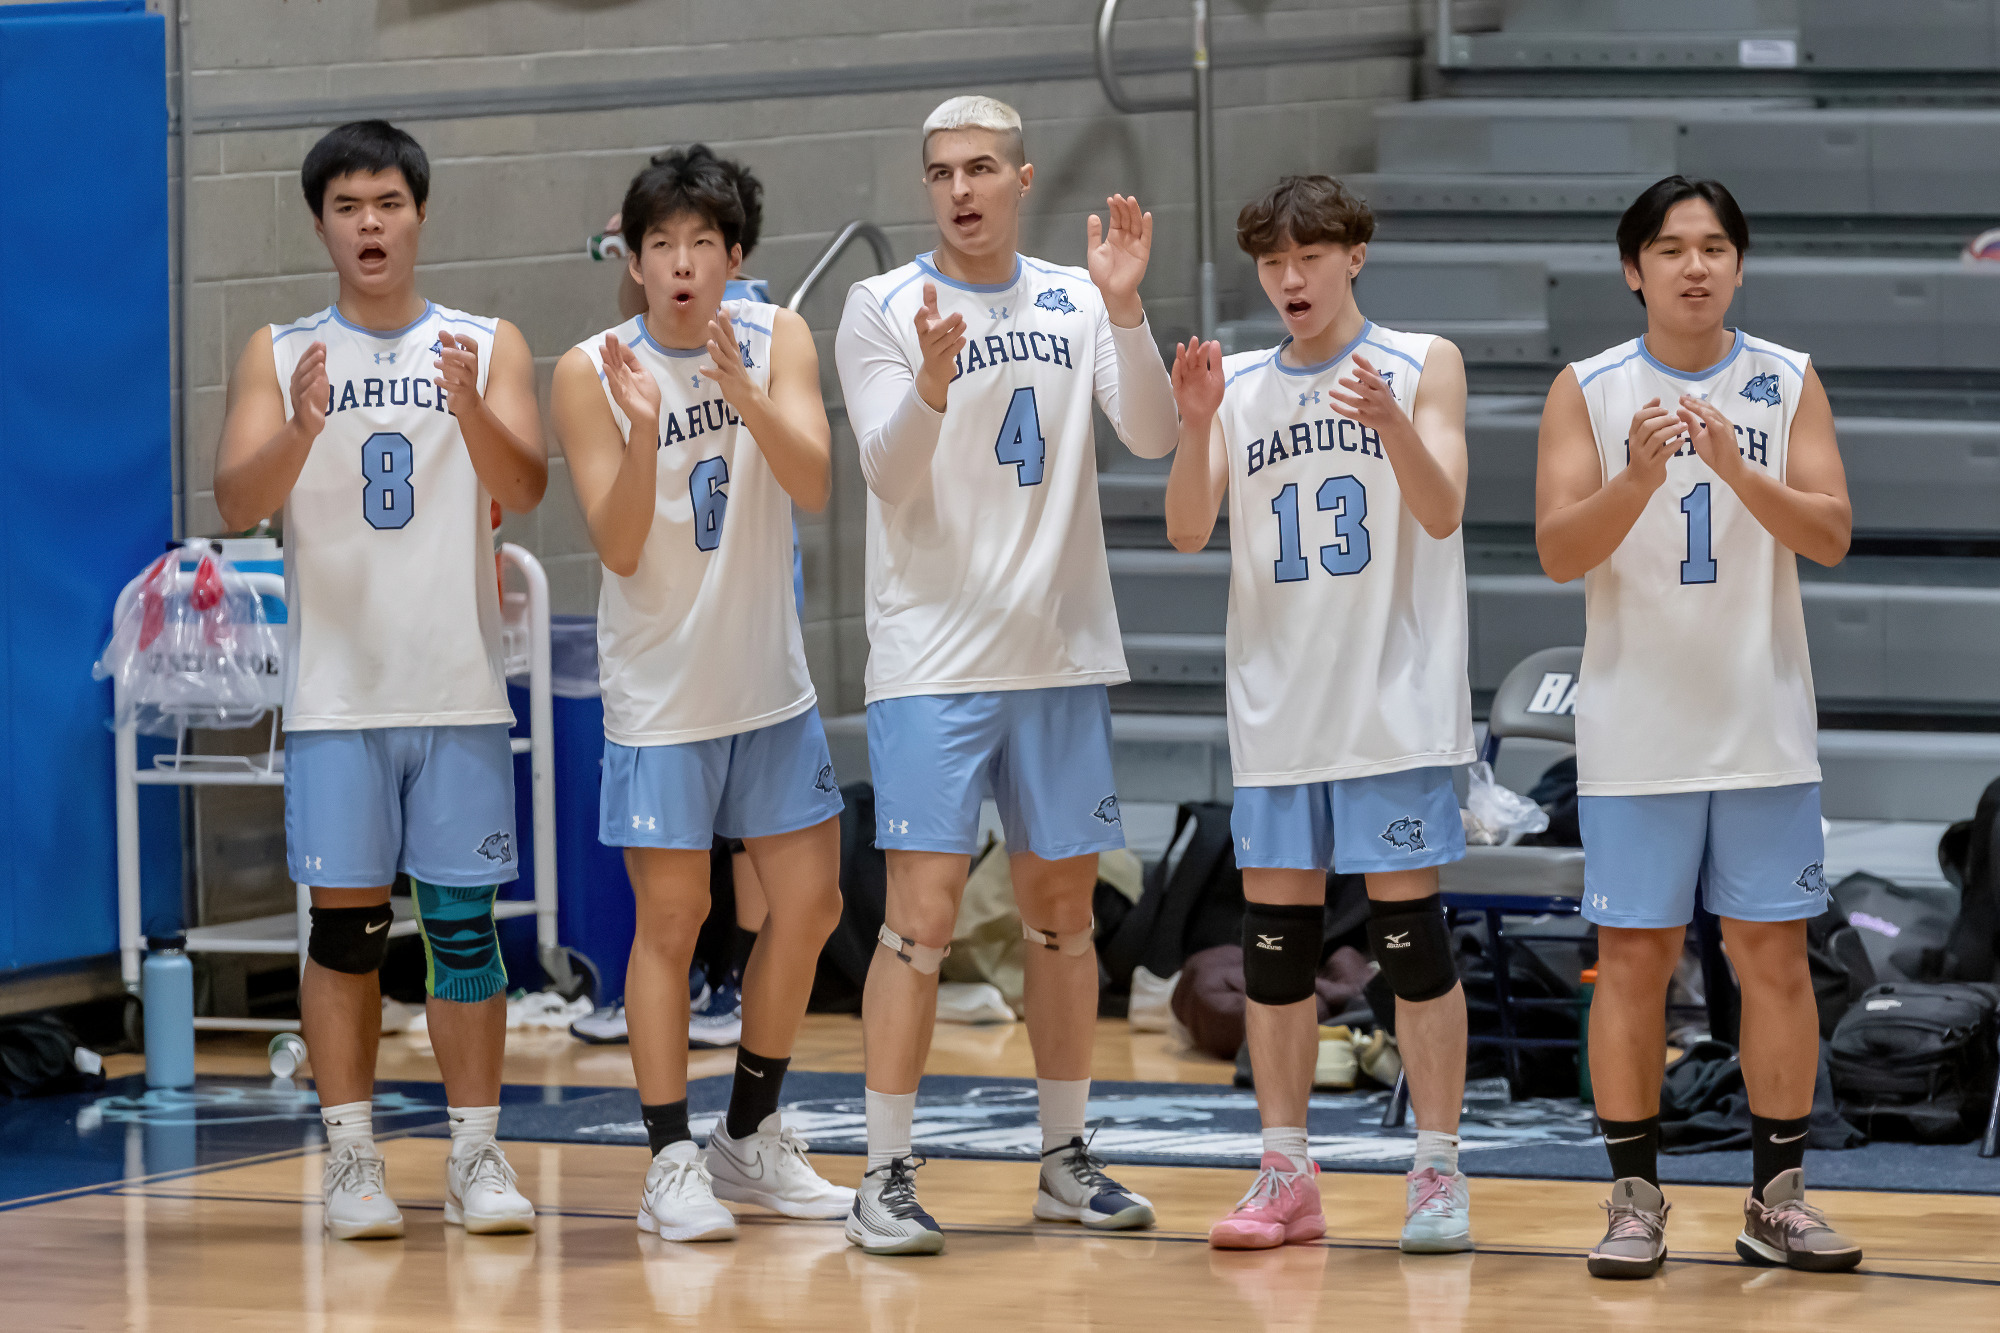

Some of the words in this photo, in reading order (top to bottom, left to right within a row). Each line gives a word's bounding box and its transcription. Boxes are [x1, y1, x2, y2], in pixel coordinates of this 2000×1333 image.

[657, 399, 747, 451] ARUC
[995, 386, 1046, 487] 4
[1247, 419, 1384, 477] BARUCH
[361, 432, 414, 530] 8
[689, 455, 729, 552] 6
[1271, 474, 1371, 583] 13
[1680, 482, 1717, 585] 1
